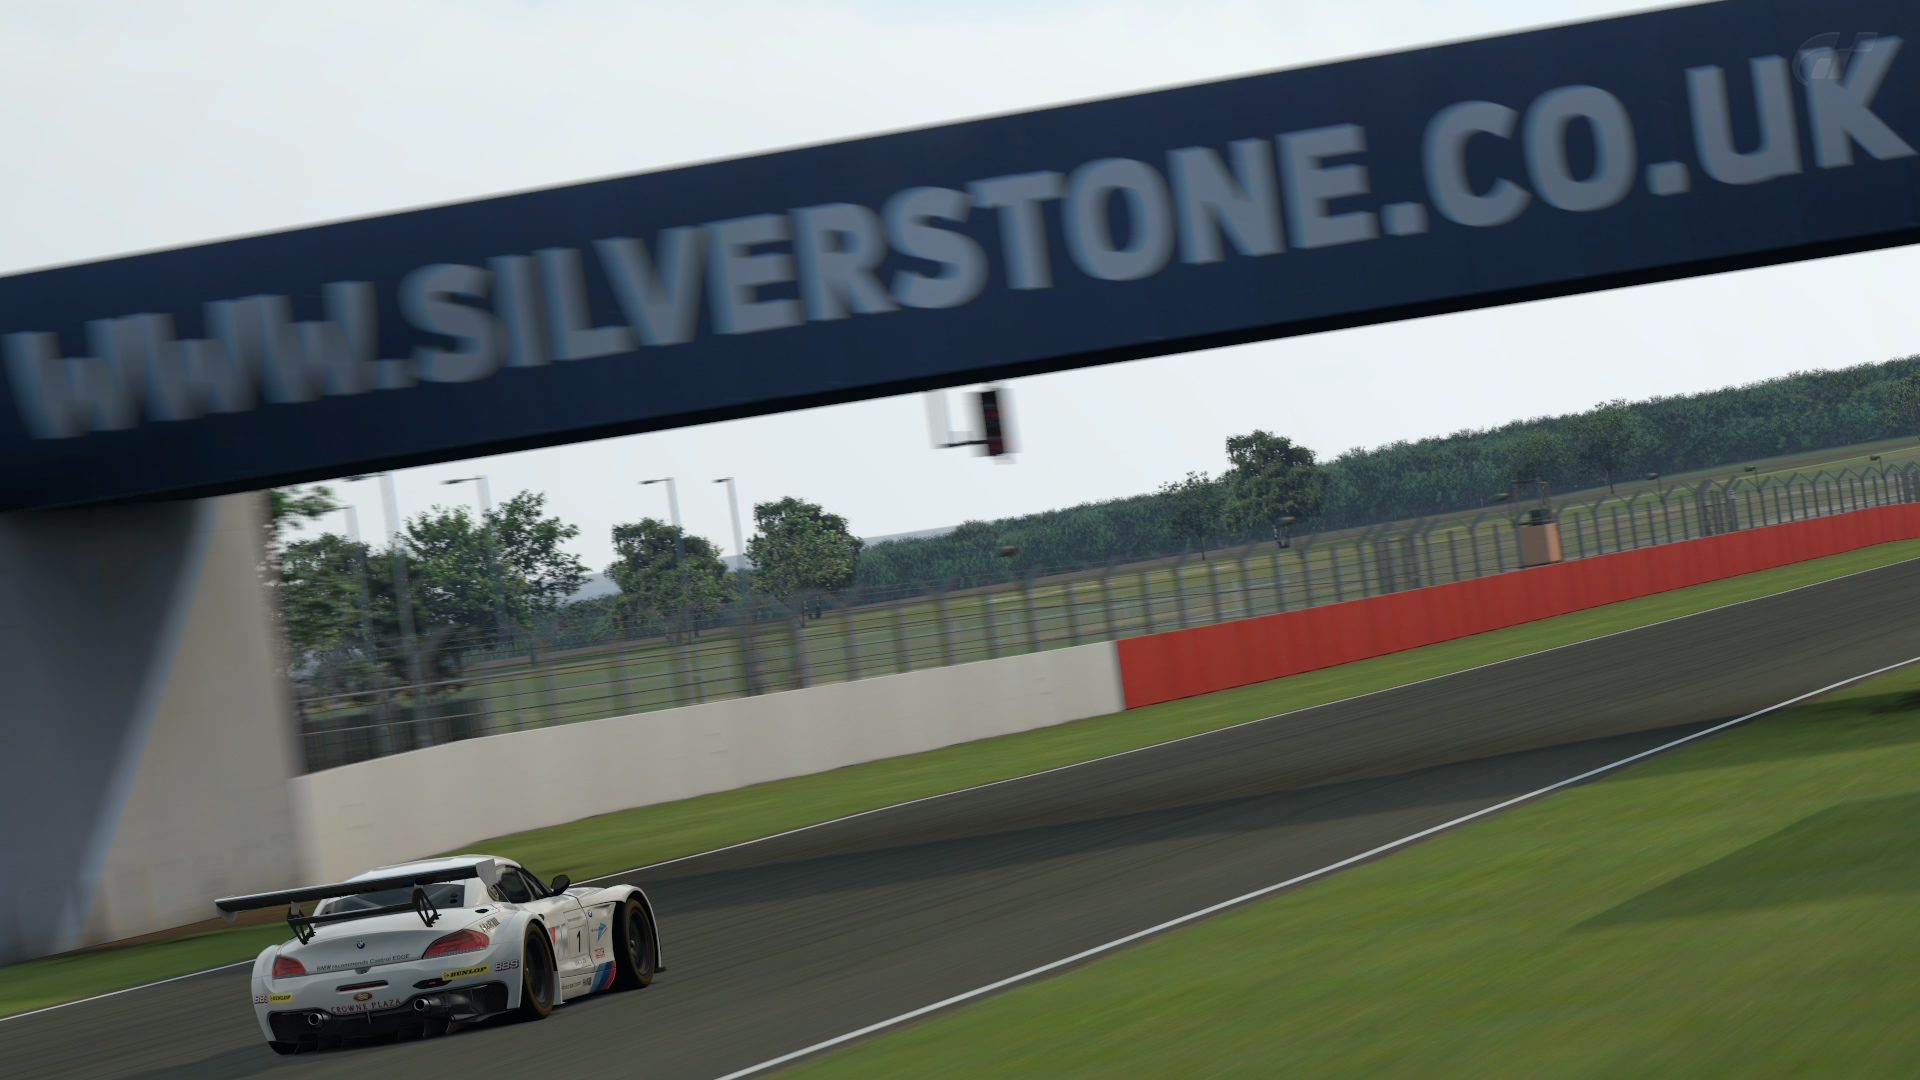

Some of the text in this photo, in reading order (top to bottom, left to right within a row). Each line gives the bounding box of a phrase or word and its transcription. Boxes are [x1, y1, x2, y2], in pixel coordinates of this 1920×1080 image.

[4, 35, 1919, 440] WWW.SILVERSTONE.CO.UK
[576, 929, 581, 953] 1
[449, 966, 488, 978] DUNLOP
[495, 959, 520, 972] BBS
[330, 998, 401, 1014] CROWNE PLAZA
